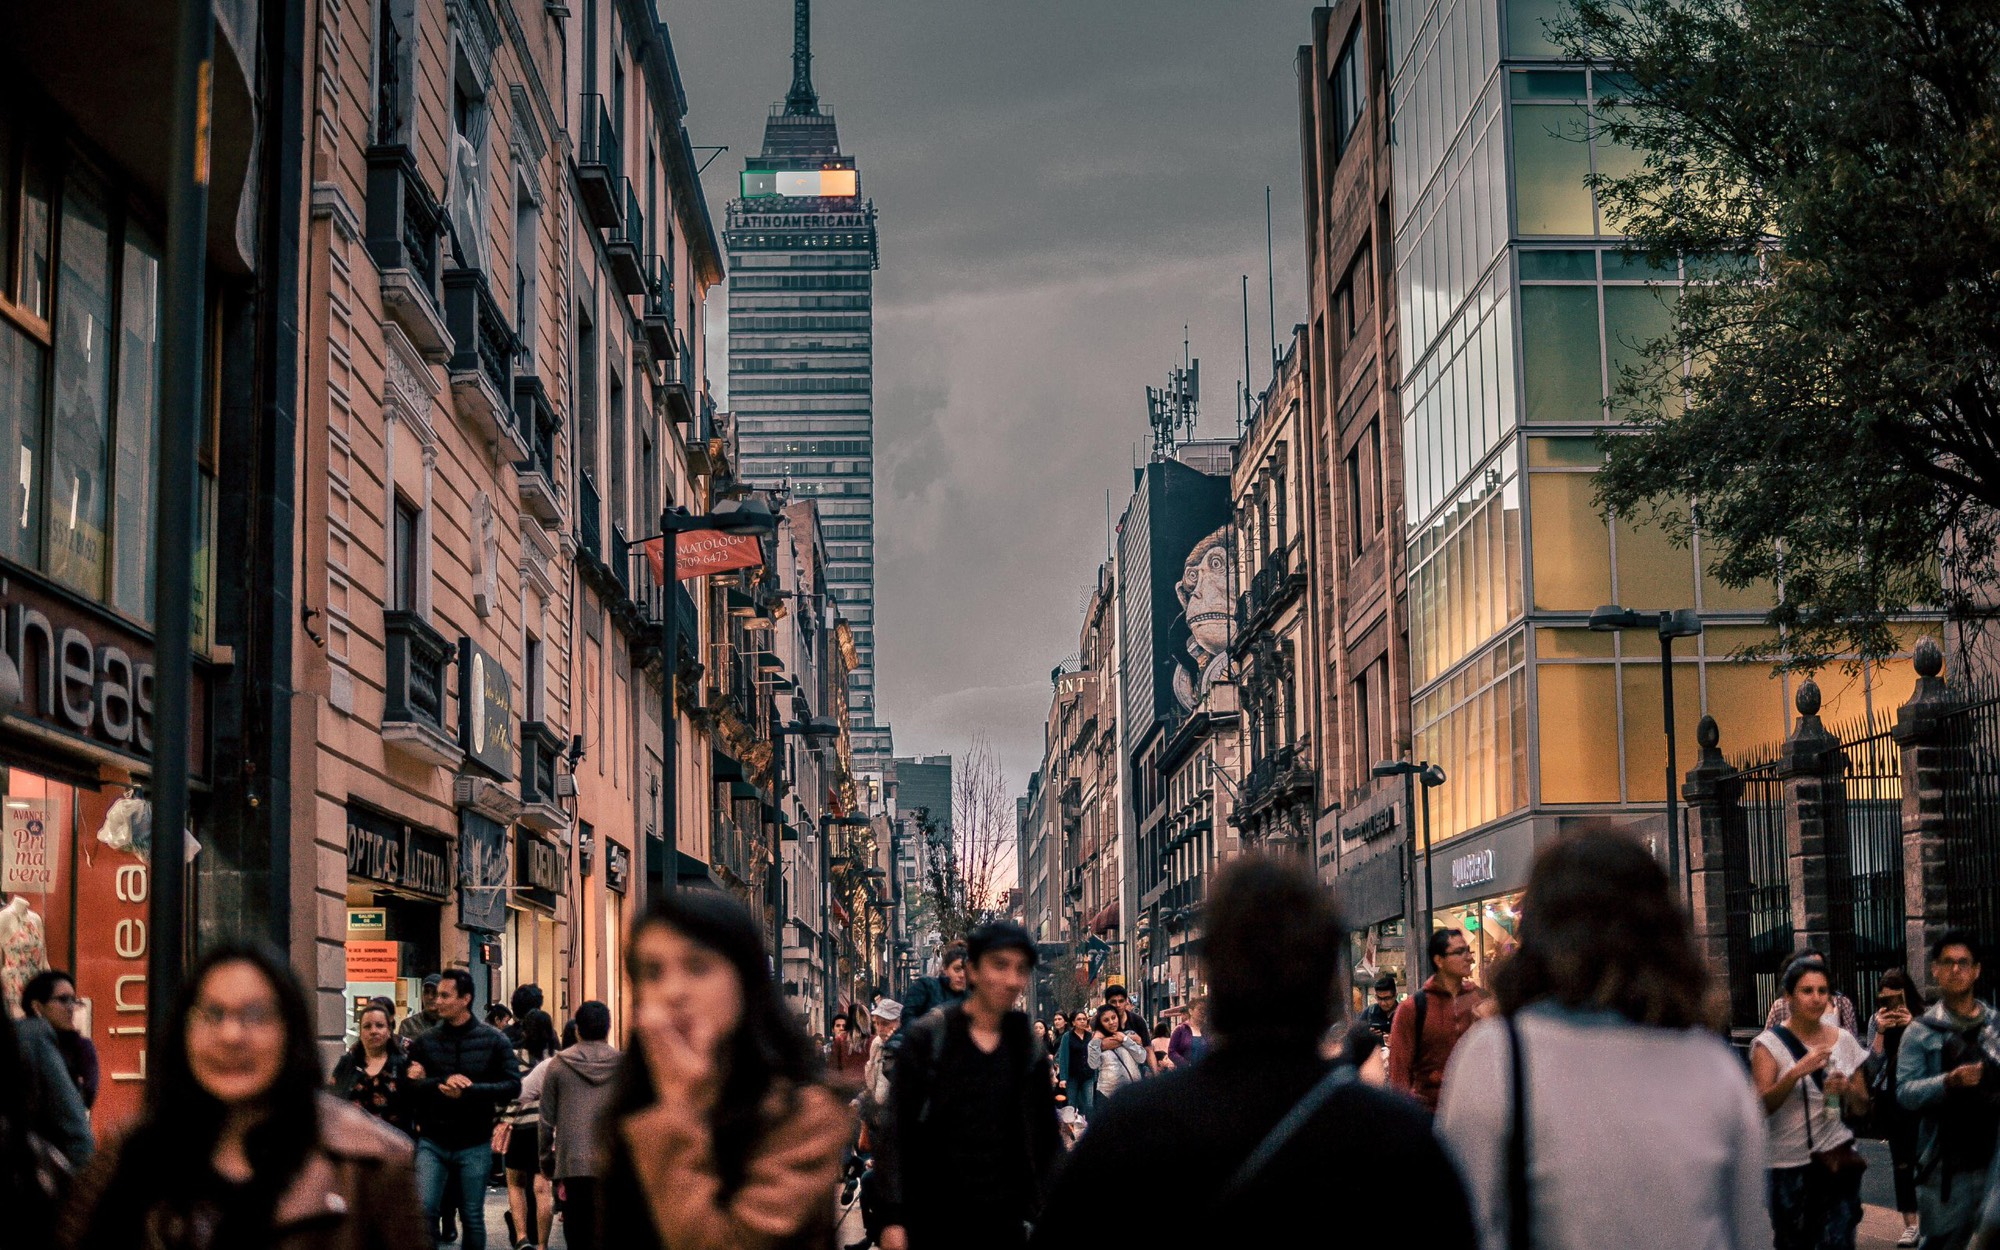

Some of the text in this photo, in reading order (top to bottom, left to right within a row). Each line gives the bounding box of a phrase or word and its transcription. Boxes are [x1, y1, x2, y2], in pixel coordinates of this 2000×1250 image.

[735, 215, 863, 228] LATINOAMERICANA
[656, 535, 747, 560] DMATÓLOGO
[677, 550, 729, 570] 5709 6473
[13, 810, 51, 821] AVANCES
[347, 824, 399, 883] OPTICAS
[9, 867, 51, 883] vera
